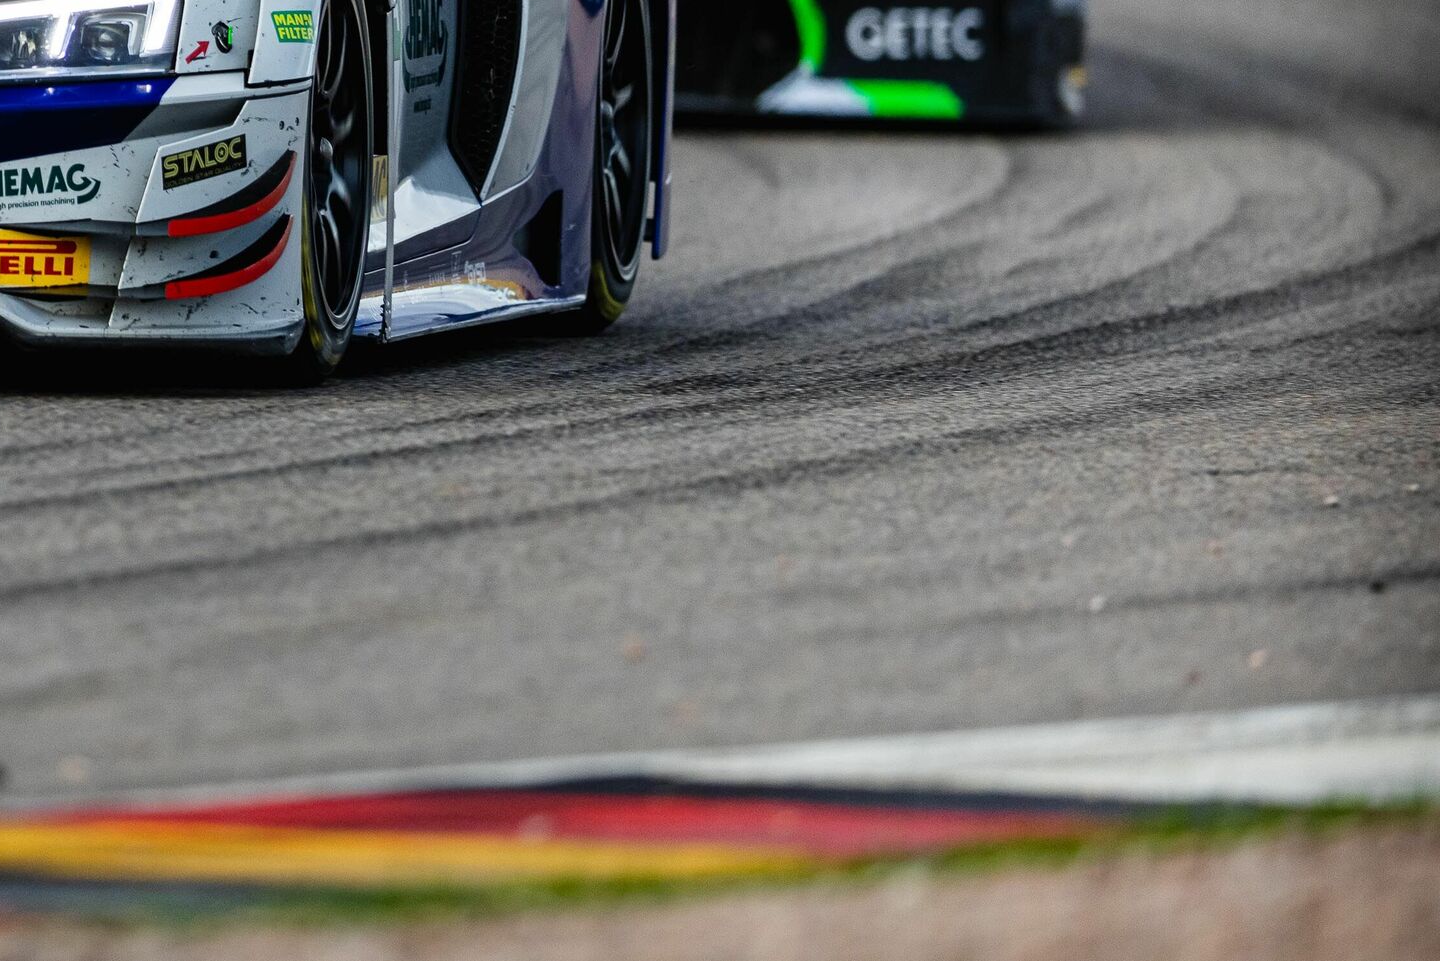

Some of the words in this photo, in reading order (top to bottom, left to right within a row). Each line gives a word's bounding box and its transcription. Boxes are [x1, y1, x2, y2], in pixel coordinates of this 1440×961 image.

[273, 13, 313, 27] MANN
[278, 27, 314, 40] FILTER
[845, 6, 985, 62] GETEC
[163, 137, 242, 178] STALOC
[7, 200, 39, 211] precision
[40, 197, 76, 207] machining
